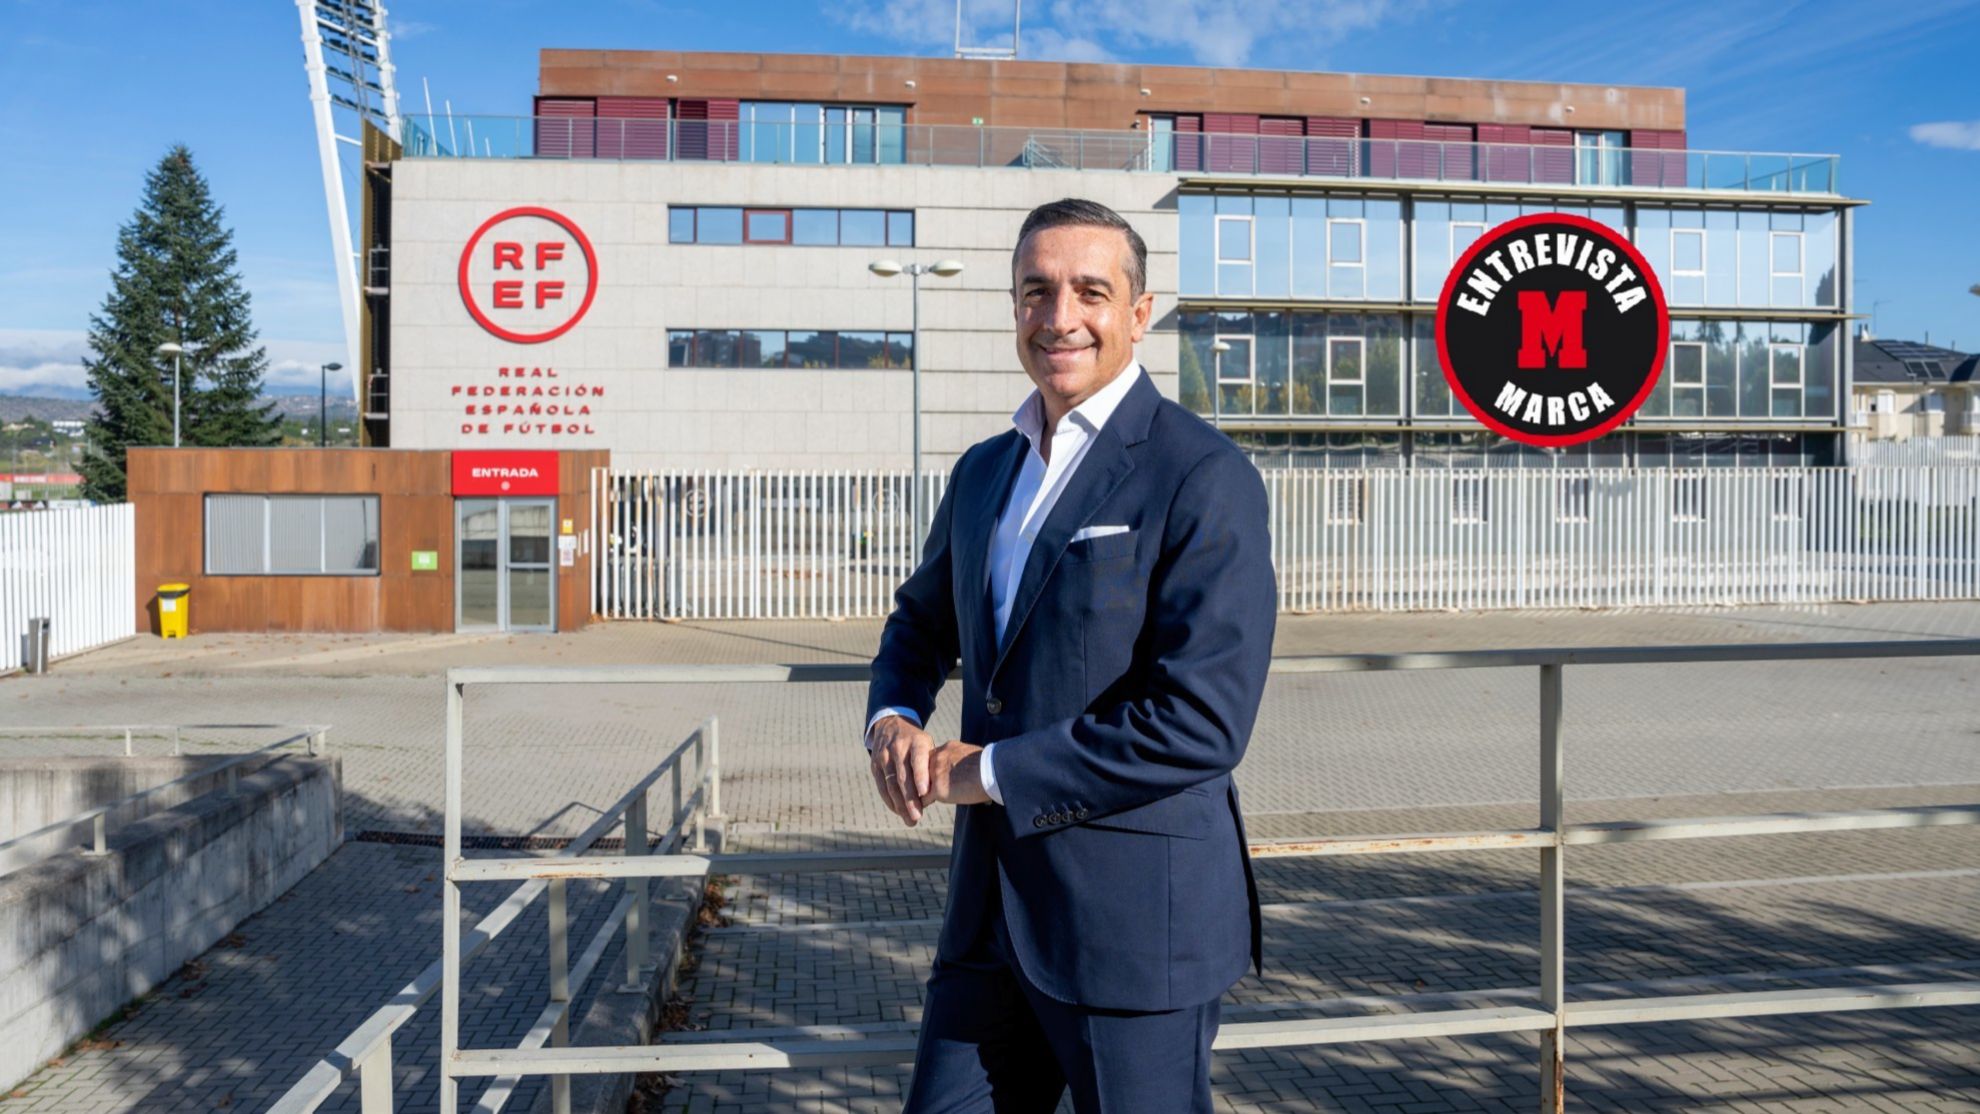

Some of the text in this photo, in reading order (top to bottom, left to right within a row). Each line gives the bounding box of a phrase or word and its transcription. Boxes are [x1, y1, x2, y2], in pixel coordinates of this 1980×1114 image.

[493, 241, 565, 270] RF
[493, 280, 565, 308] EF
[498, 366, 558, 378] REAL
[451, 383, 605, 397] FEDERACIÓN
[465, 402, 590, 415] ESPAÑOLA
[461, 420, 595, 434] DE FÚTBOL
[472, 468, 539, 477] ENTRADA
